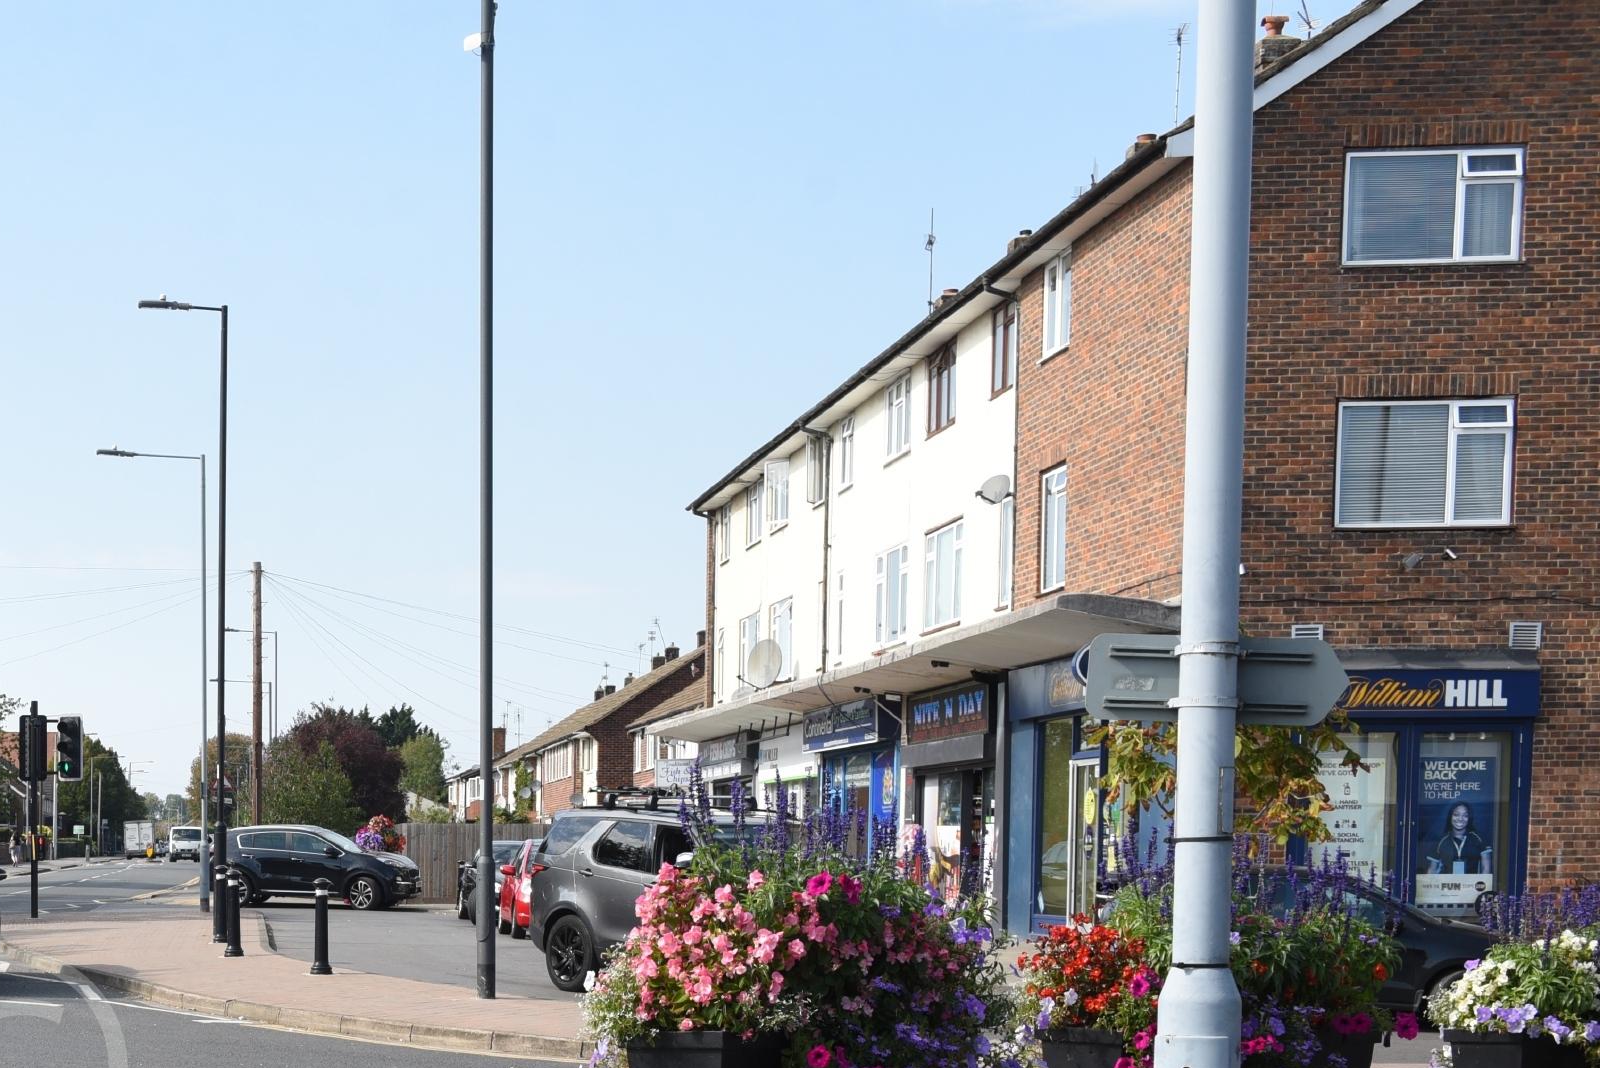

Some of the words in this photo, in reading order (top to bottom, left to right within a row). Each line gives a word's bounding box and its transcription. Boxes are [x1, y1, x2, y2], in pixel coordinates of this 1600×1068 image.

[1445, 679, 1508, 707] HILL
[913, 701, 940, 725] NITE
[944, 697, 953, 719] N
[958, 690, 985, 716] DAY
[1424, 760, 1487, 771] WELCOME
[1424, 770, 1457, 780] BACK
[1424, 781, 1453, 791] WE'RE
[1455, 781, 1481, 791] HERE
[1424, 790, 1436, 800] TO
[1437, 790, 1461, 800] HELP
[1440, 882, 1462, 891] FUN
